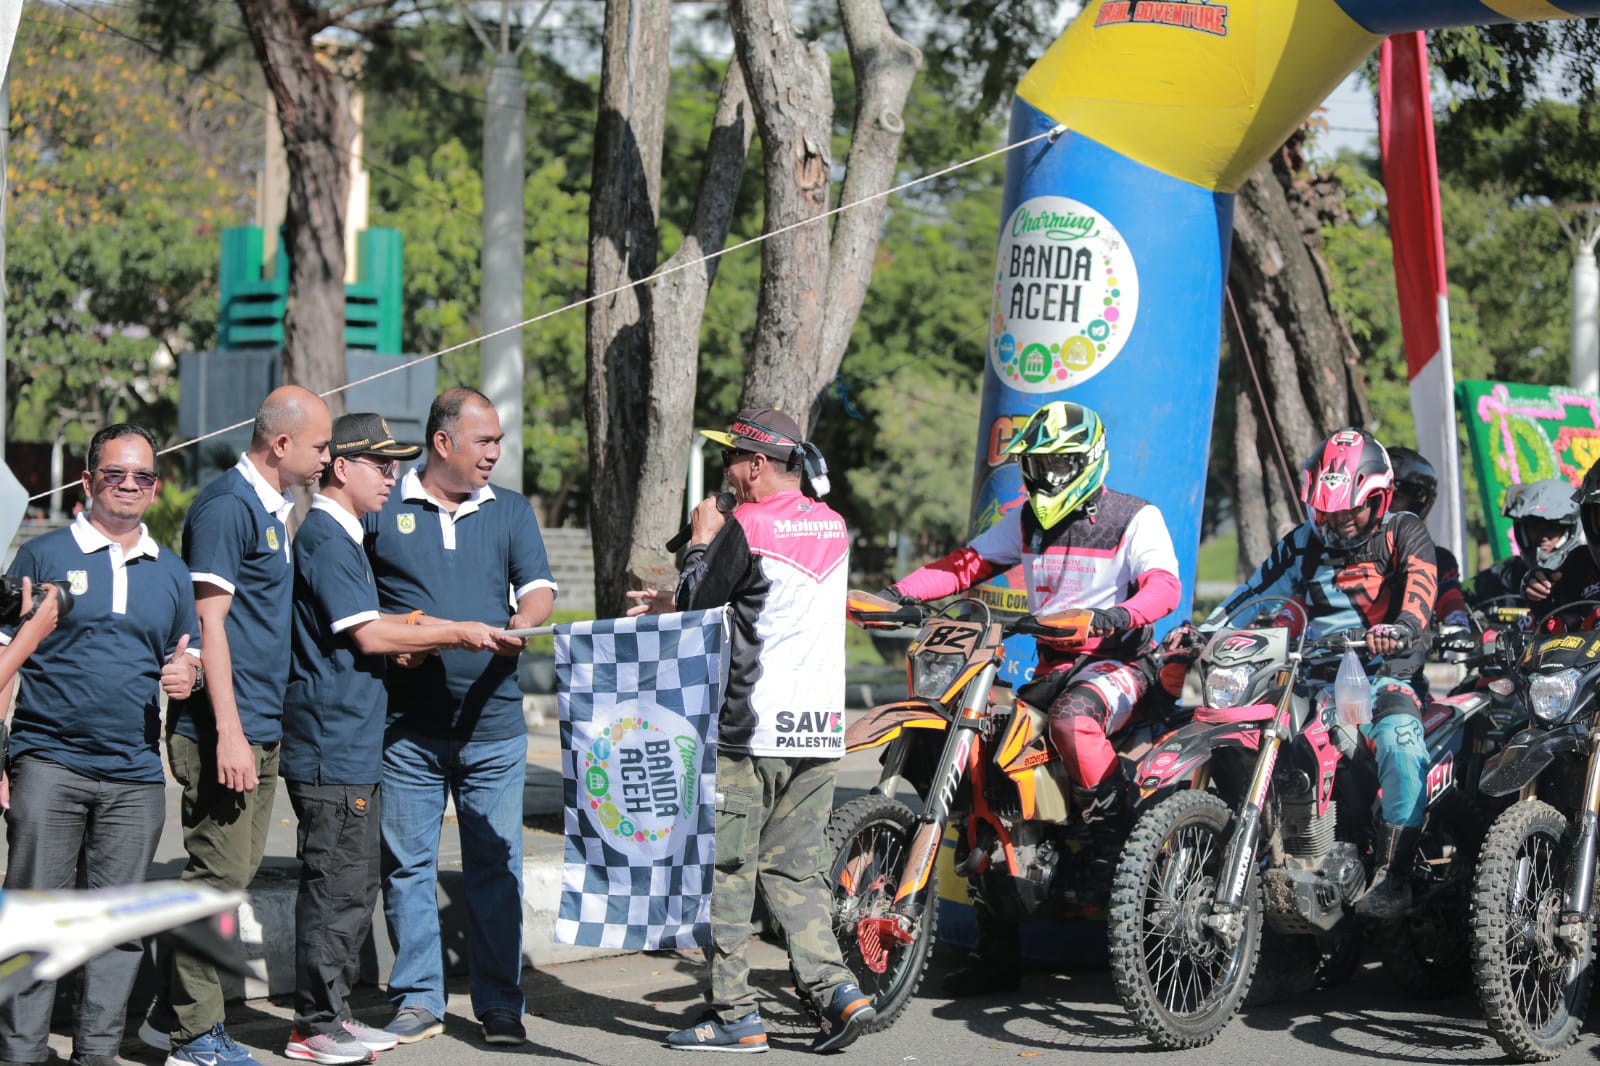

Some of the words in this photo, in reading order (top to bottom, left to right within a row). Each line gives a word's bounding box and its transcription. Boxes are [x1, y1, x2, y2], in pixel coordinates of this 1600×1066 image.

[1132, 1, 1227, 36] ADVENTURE
[1012, 207, 1100, 241] Charming
[1009, 244, 1093, 281] BANDA
[1009, 282, 1083, 323] ACEH
[773, 518, 844, 533] Maimun
[926, 625, 978, 649] 82
[775, 711, 843, 733] SAVE
[775, 736, 843, 748] PALESTINE
[619, 748, 653, 814] ACEH
[644, 739, 680, 818] BANDA
